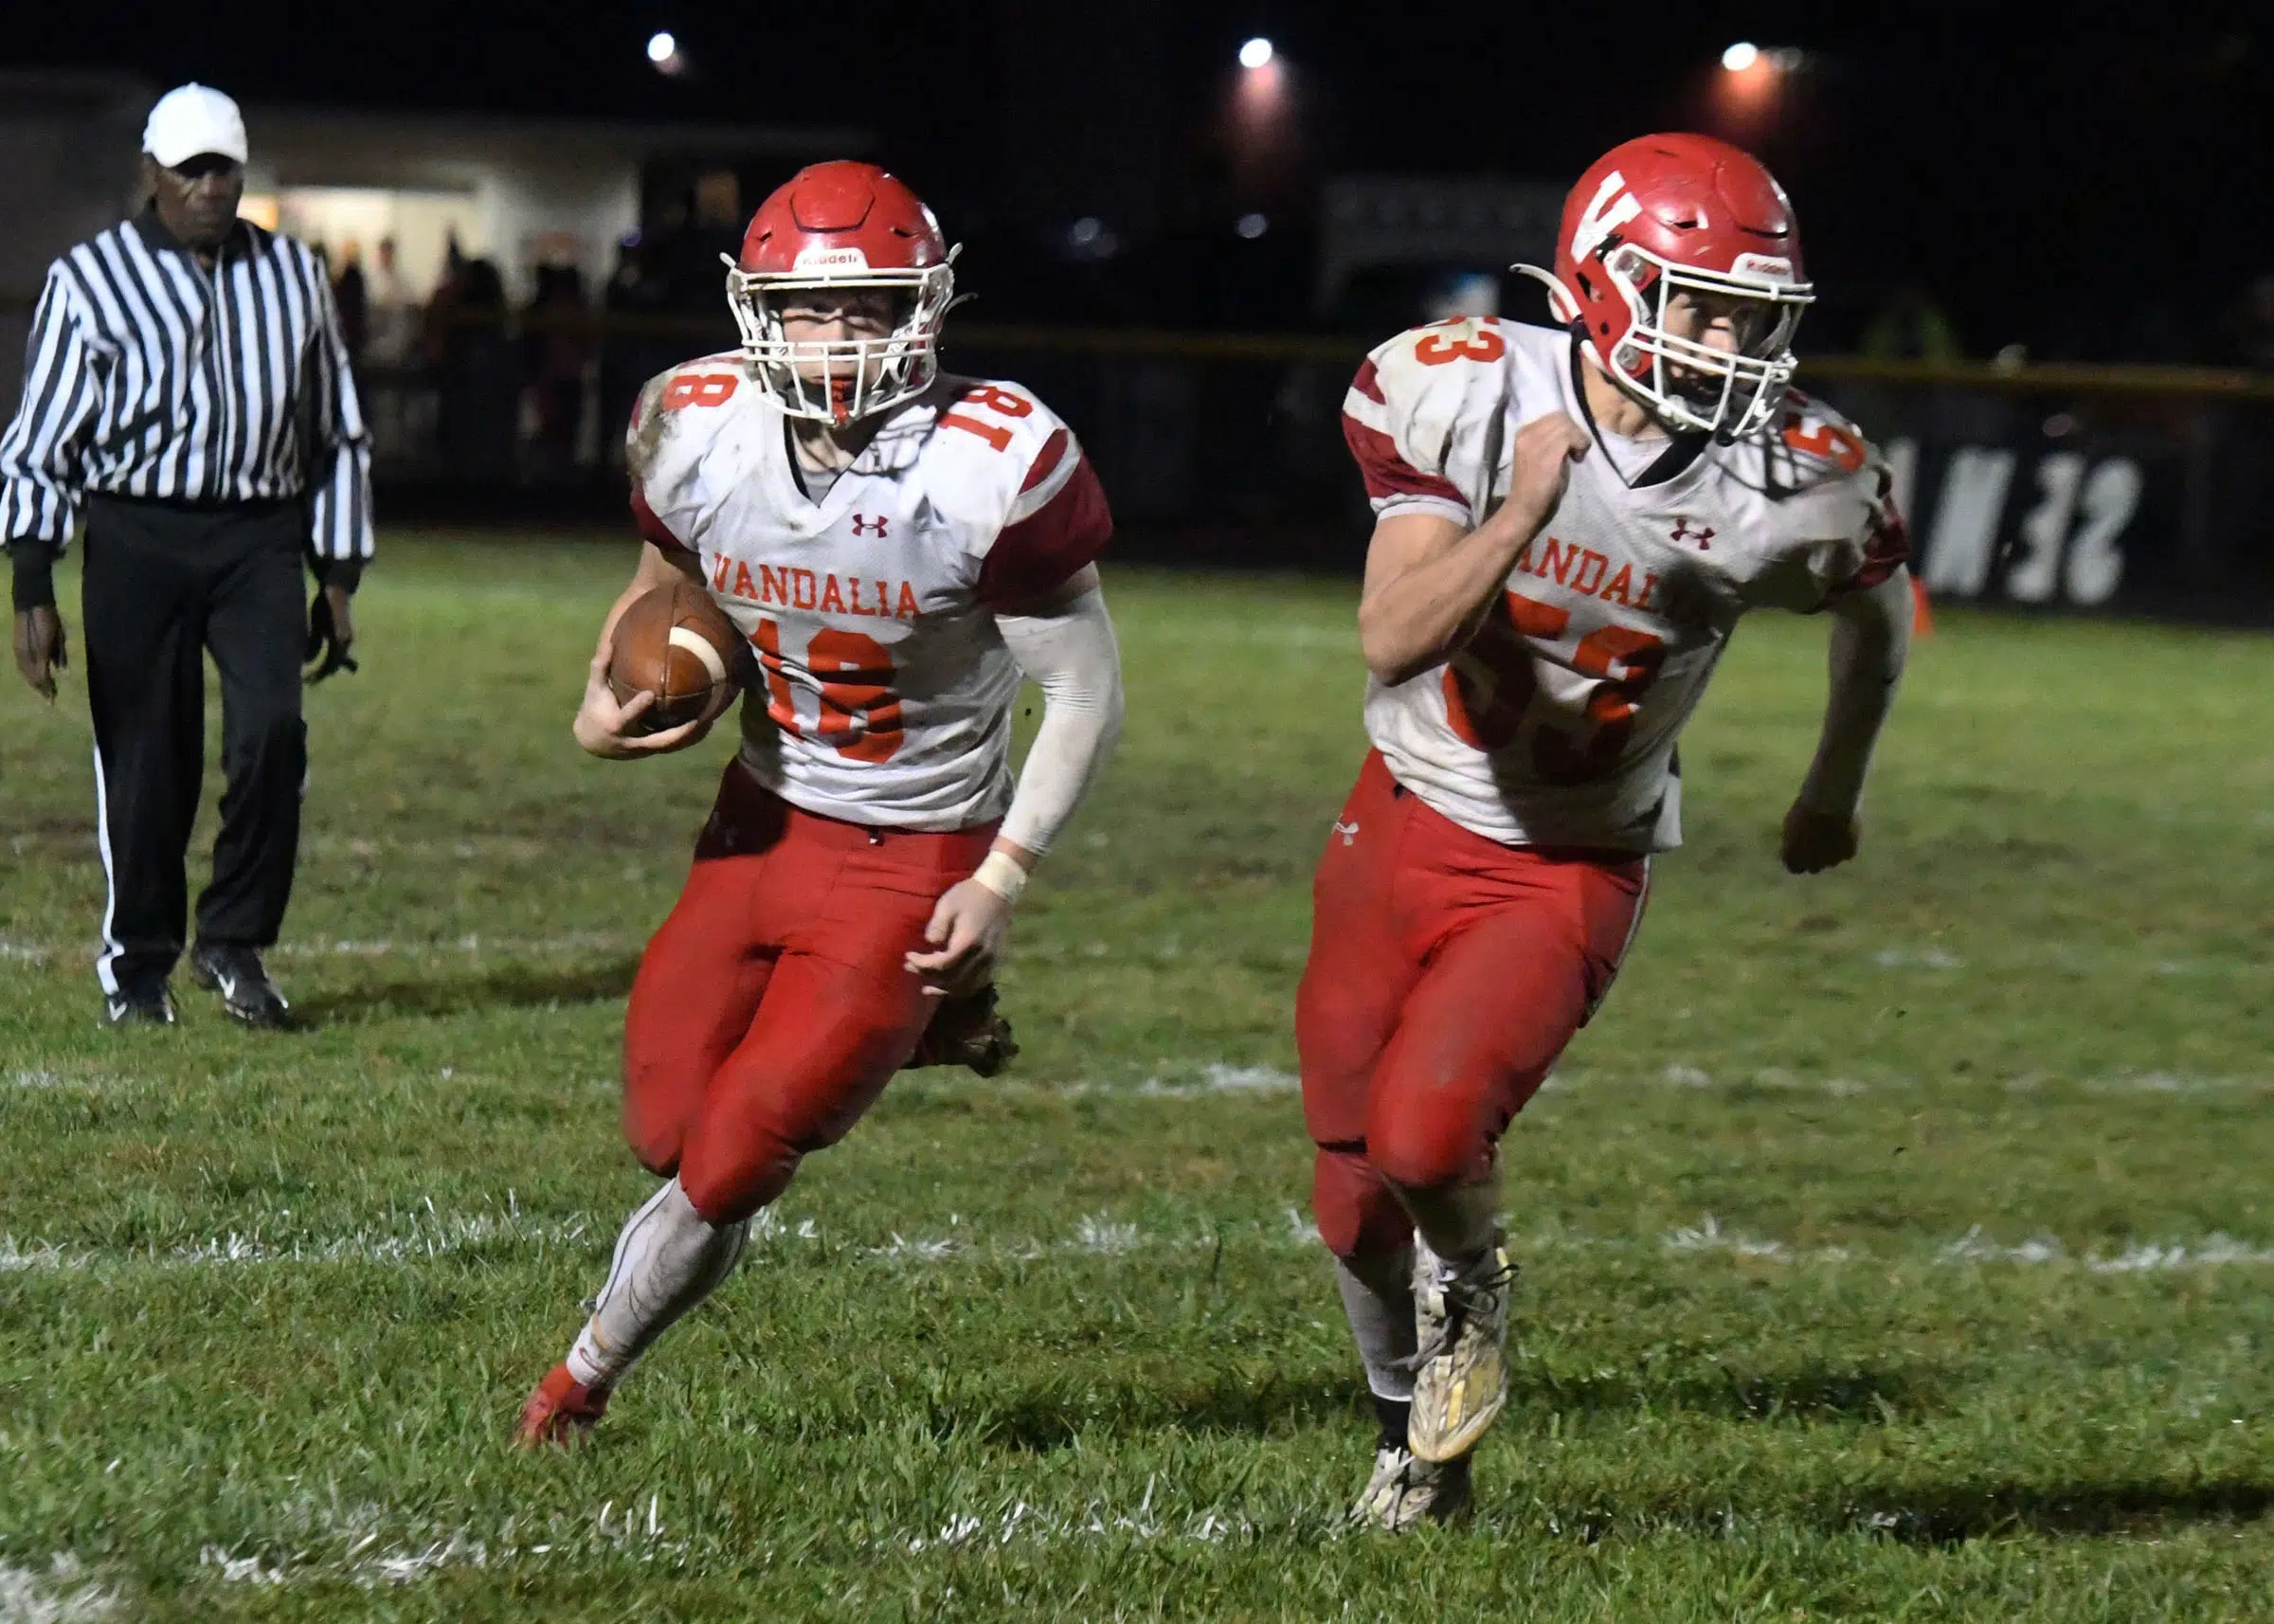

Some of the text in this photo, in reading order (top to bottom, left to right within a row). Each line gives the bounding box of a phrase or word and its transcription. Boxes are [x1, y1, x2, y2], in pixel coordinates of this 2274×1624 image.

[1416, 315, 1506, 367] 3
[934, 383, 1034, 452] 18
[713, 551, 925, 620] VANDALIA
[749, 618, 904, 764] 18
